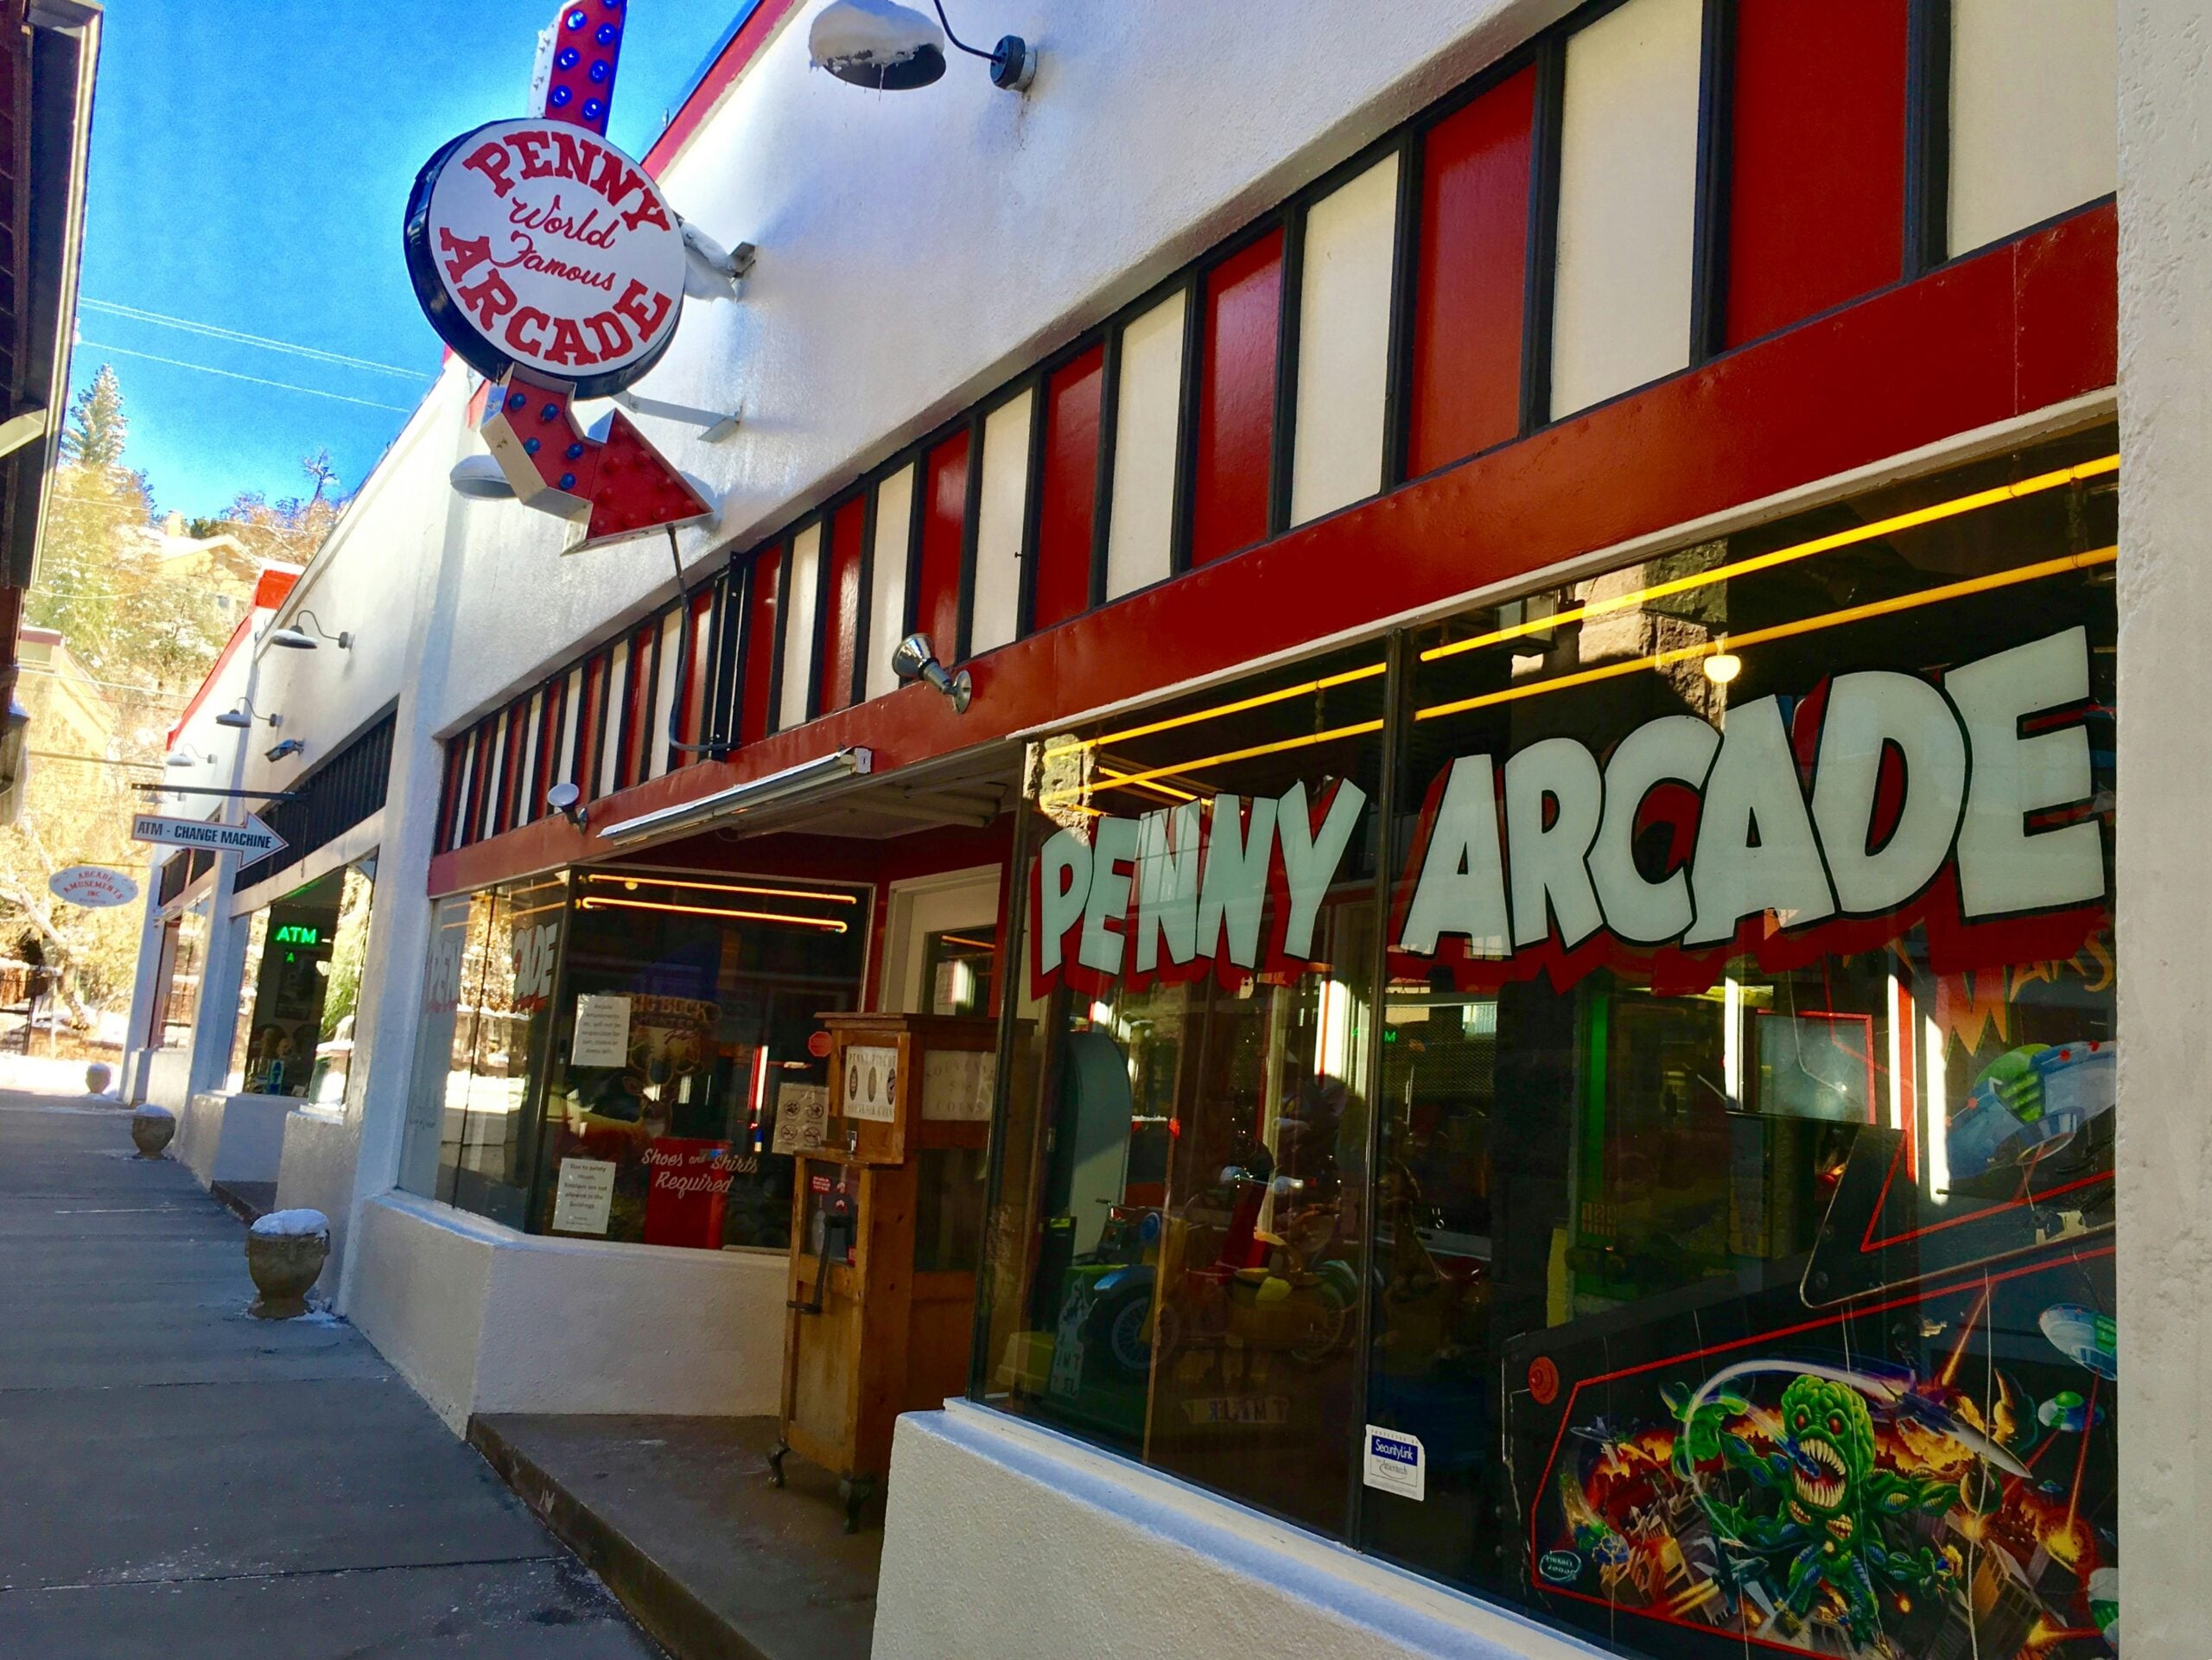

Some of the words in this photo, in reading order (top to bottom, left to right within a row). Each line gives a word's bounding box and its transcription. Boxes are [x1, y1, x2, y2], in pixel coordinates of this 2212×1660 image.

[461, 130, 671, 232] PENNY
[509, 194, 620, 249] World
[490, 230, 617, 291] Famous
[439, 226, 672, 366] ARCADE
[1396, 624, 2107, 961] ARCADE
[137, 821, 163, 836] ATM
[175, 825, 219, 843] CHANGE
[220, 830, 272, 849] MACHINE
[79, 871, 113, 881] ARCADE
[1035, 776, 1367, 980] PENNY
[63, 881, 124, 900] AMUSEMENTS
[276, 925, 317, 944] ATM
[641, 1148, 683, 1167] Shoes
[688, 1154, 707, 1164] and
[710, 1154, 758, 1173] Shirts
[655, 1171, 734, 1199] Required
[1375, 1439, 1414, 1460] SecurityLink
